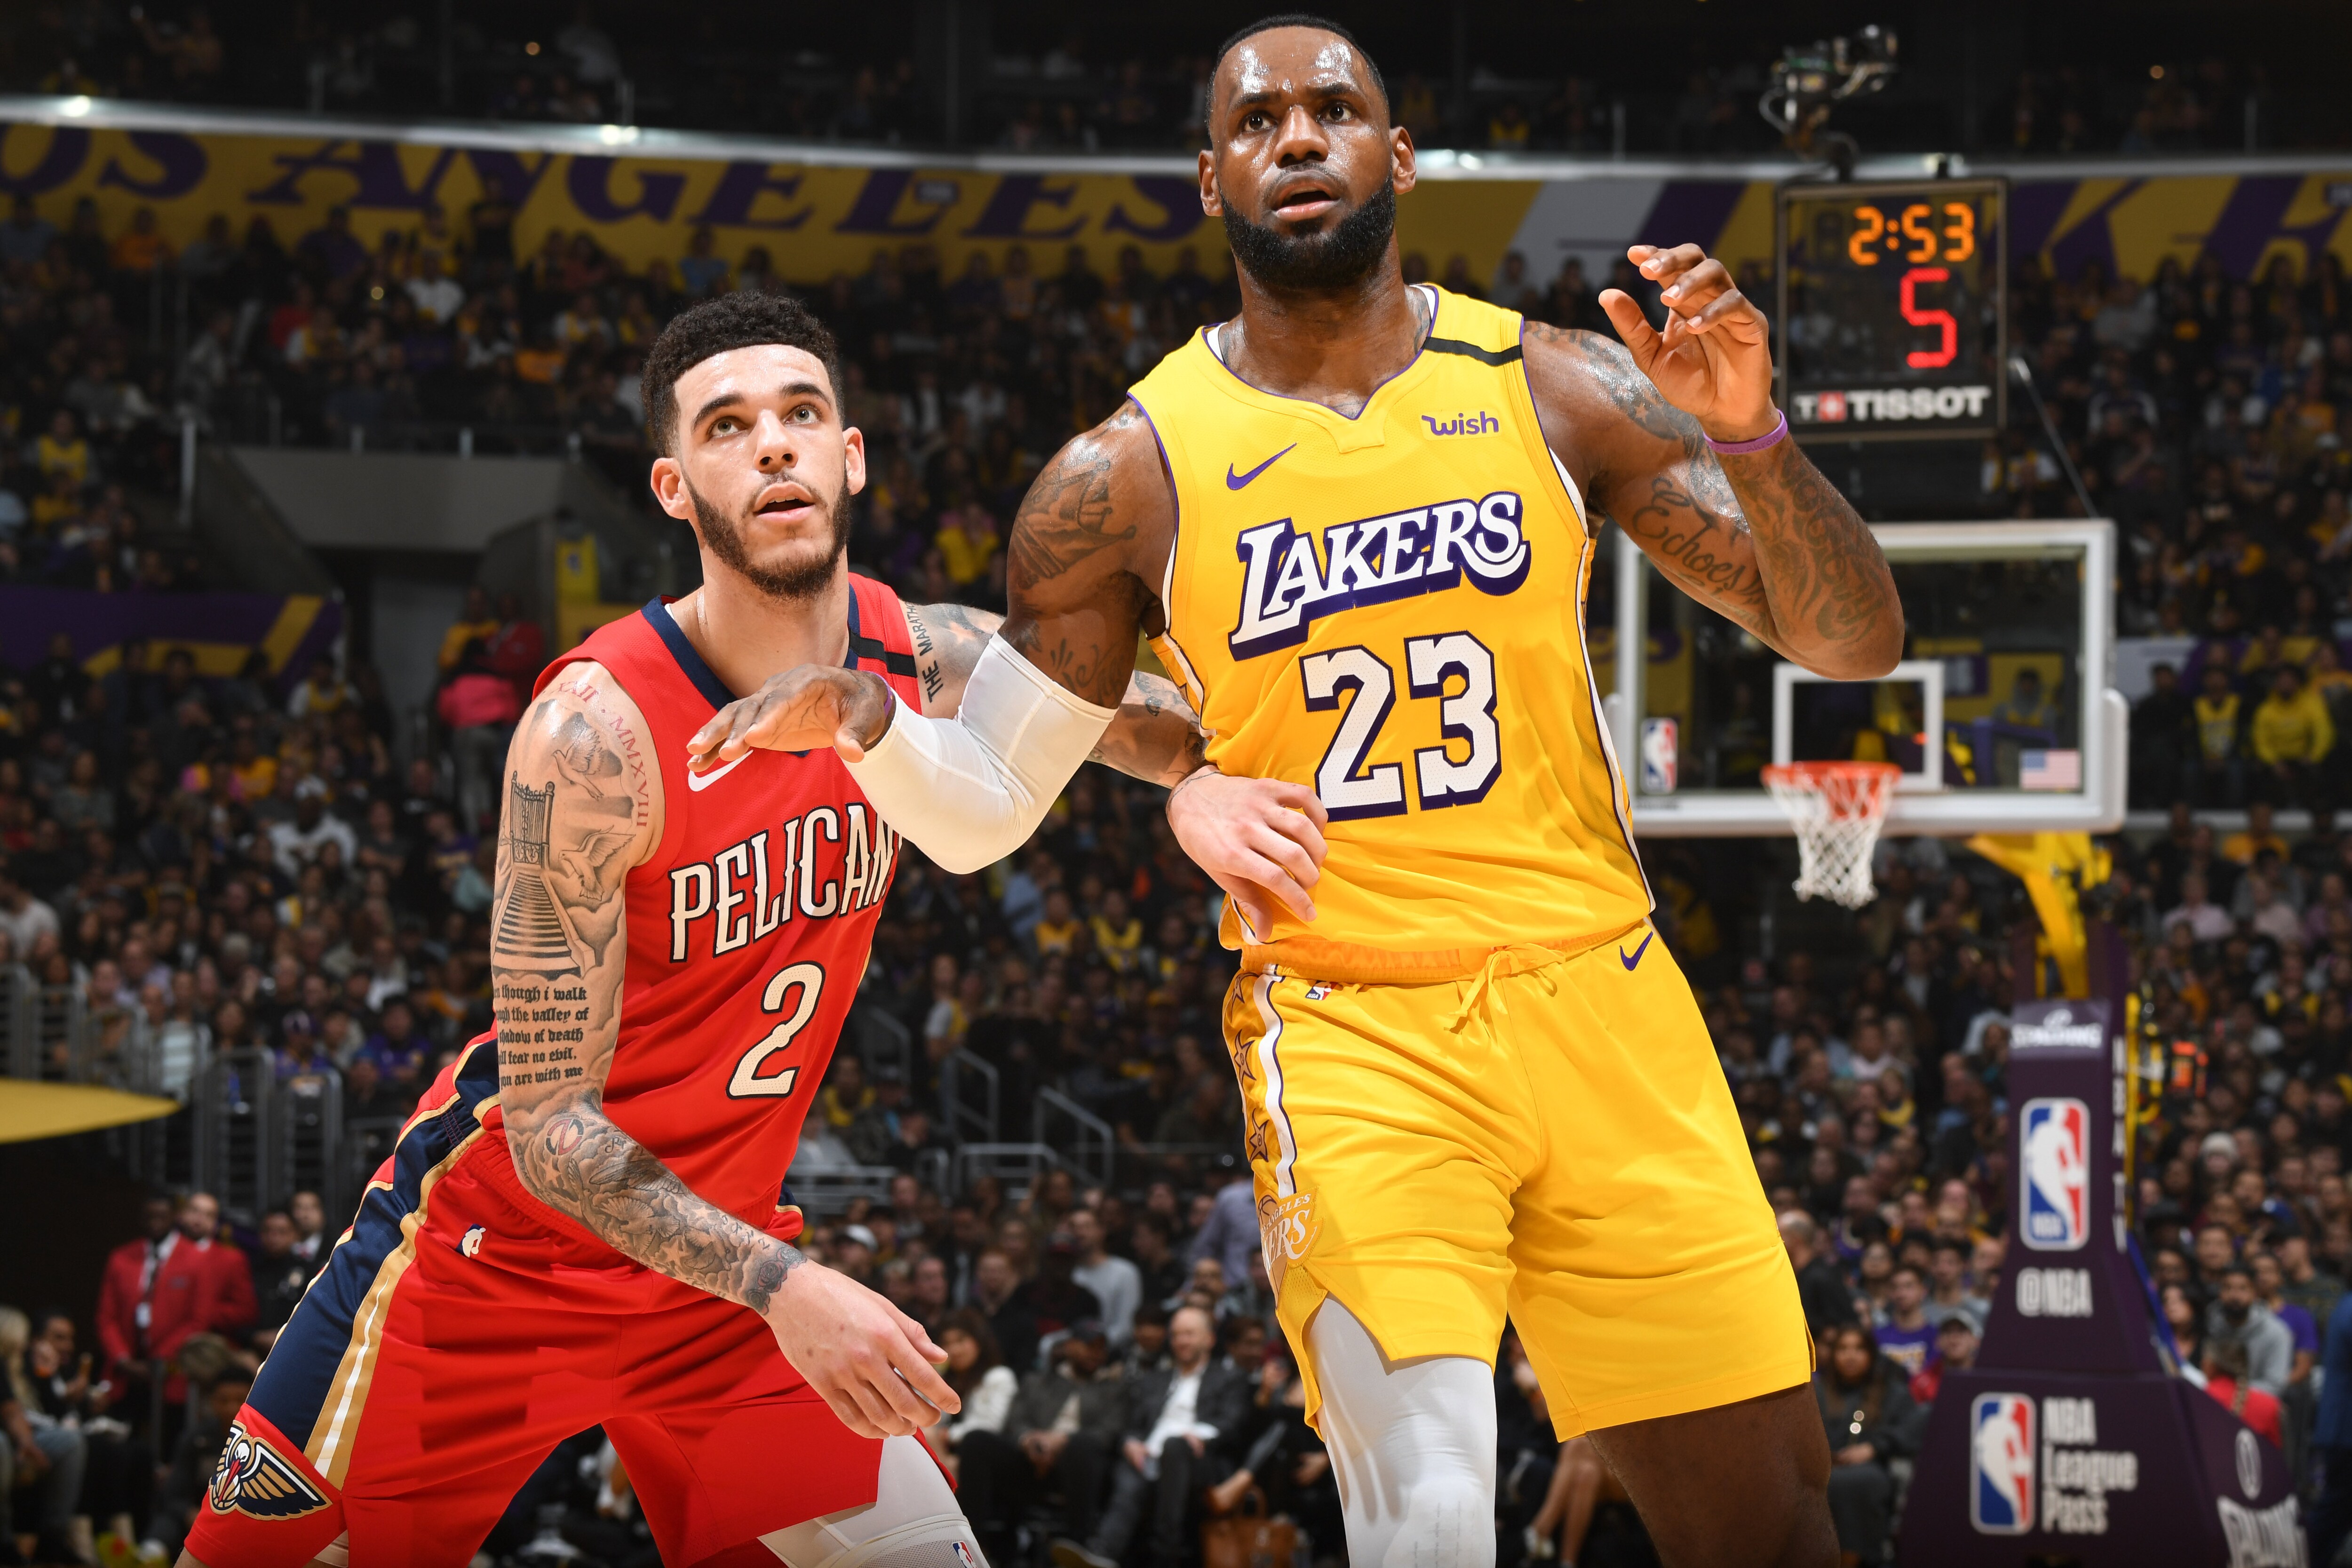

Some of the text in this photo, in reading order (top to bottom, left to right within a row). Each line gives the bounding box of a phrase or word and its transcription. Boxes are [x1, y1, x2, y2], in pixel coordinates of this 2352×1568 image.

[1849, 202, 1975, 266] 2:53
[1899, 267, 1958, 368] 5
[1422, 411, 1499, 436] wish
[1848, 386, 1991, 422] TISSOT
[1747, 436, 1779, 452] Akron
[1228, 492, 1531, 662] LAKERS
[922, 660, 944, 703] THE
[1298, 630, 1502, 822] 23
[608, 715, 649, 827] MMXVIII
[669, 801, 903, 963] PELICAN
[502, 984, 540, 1003] though
[554, 987, 587, 1001] walk
[512, 1007, 529, 1023] the
[532, 1008, 571, 1023] valley
[575, 1008, 589, 1021] of
[534, 1029, 545, 1043] of
[548, 1027, 583, 1043] death
[725, 961, 826, 1100] 2
[508, 1051, 529, 1064] fear
[532, 1053, 546, 1063] no
[515, 1073, 532, 1086] are
[535, 1067, 560, 1083] with
[564, 1067, 583, 1078] me
[1266, 1194, 1311, 1229] ANGELES
[2017, 1267, 2094, 1317] @NBA
[2042, 1397, 2097, 1445] NBA
[2042, 1444, 2138, 1498] League
[2042, 1489, 2108, 1534] Pass
